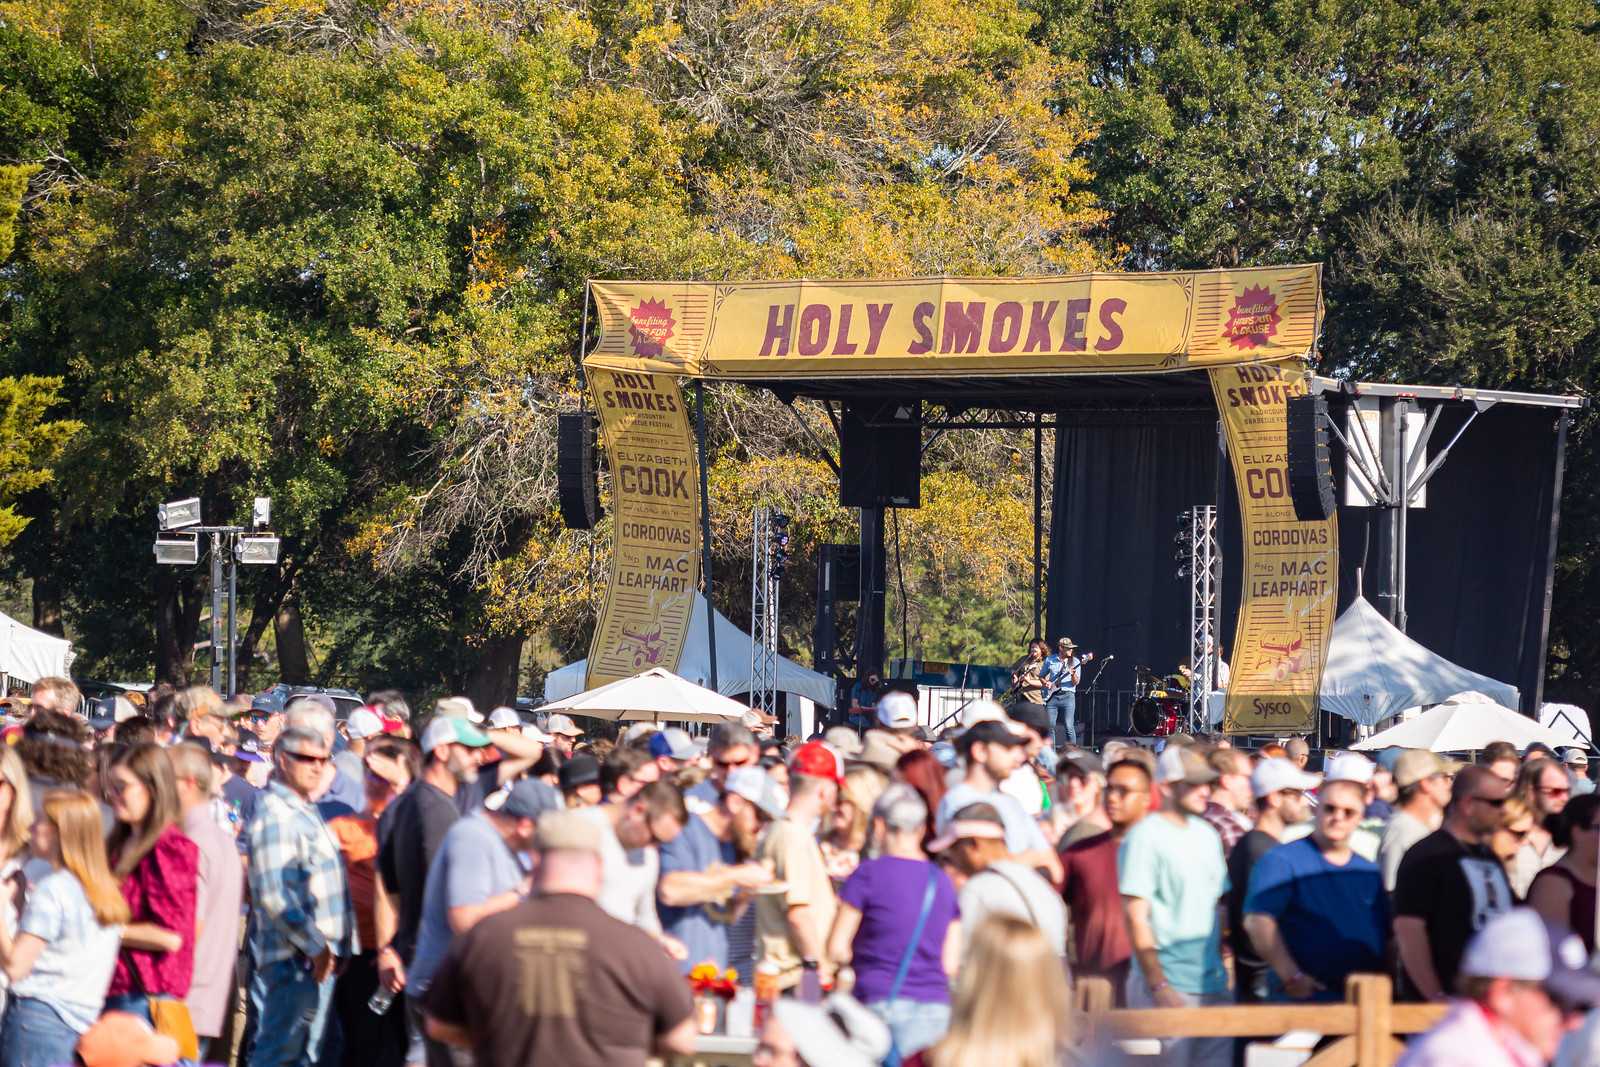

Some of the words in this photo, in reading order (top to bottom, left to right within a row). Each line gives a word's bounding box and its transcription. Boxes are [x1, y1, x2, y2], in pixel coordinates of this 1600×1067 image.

[759, 303, 893, 357] HOLY
[907, 297, 1128, 356] SMOKES
[1239, 324, 1271, 335] CAUSE
[610, 372, 656, 390] HOLY
[1235, 364, 1283, 383] HOLY
[603, 390, 677, 413] SMOKES
[617, 451, 688, 466] ELIZABETH
[1243, 453, 1289, 465] ELIZA
[619, 465, 690, 500] COOK
[623, 522, 691, 545] CORDOVAS
[1253, 528, 1328, 546] CORDOVAS
[646, 555, 689, 574] MAC
[1254, 561, 1274, 573] AND
[1281, 561, 1327, 577] MAC
[617, 571, 688, 593] LEAPHART
[1252, 580, 1328, 598] LEAPHART
[1253, 698, 1292, 719] Sysco
